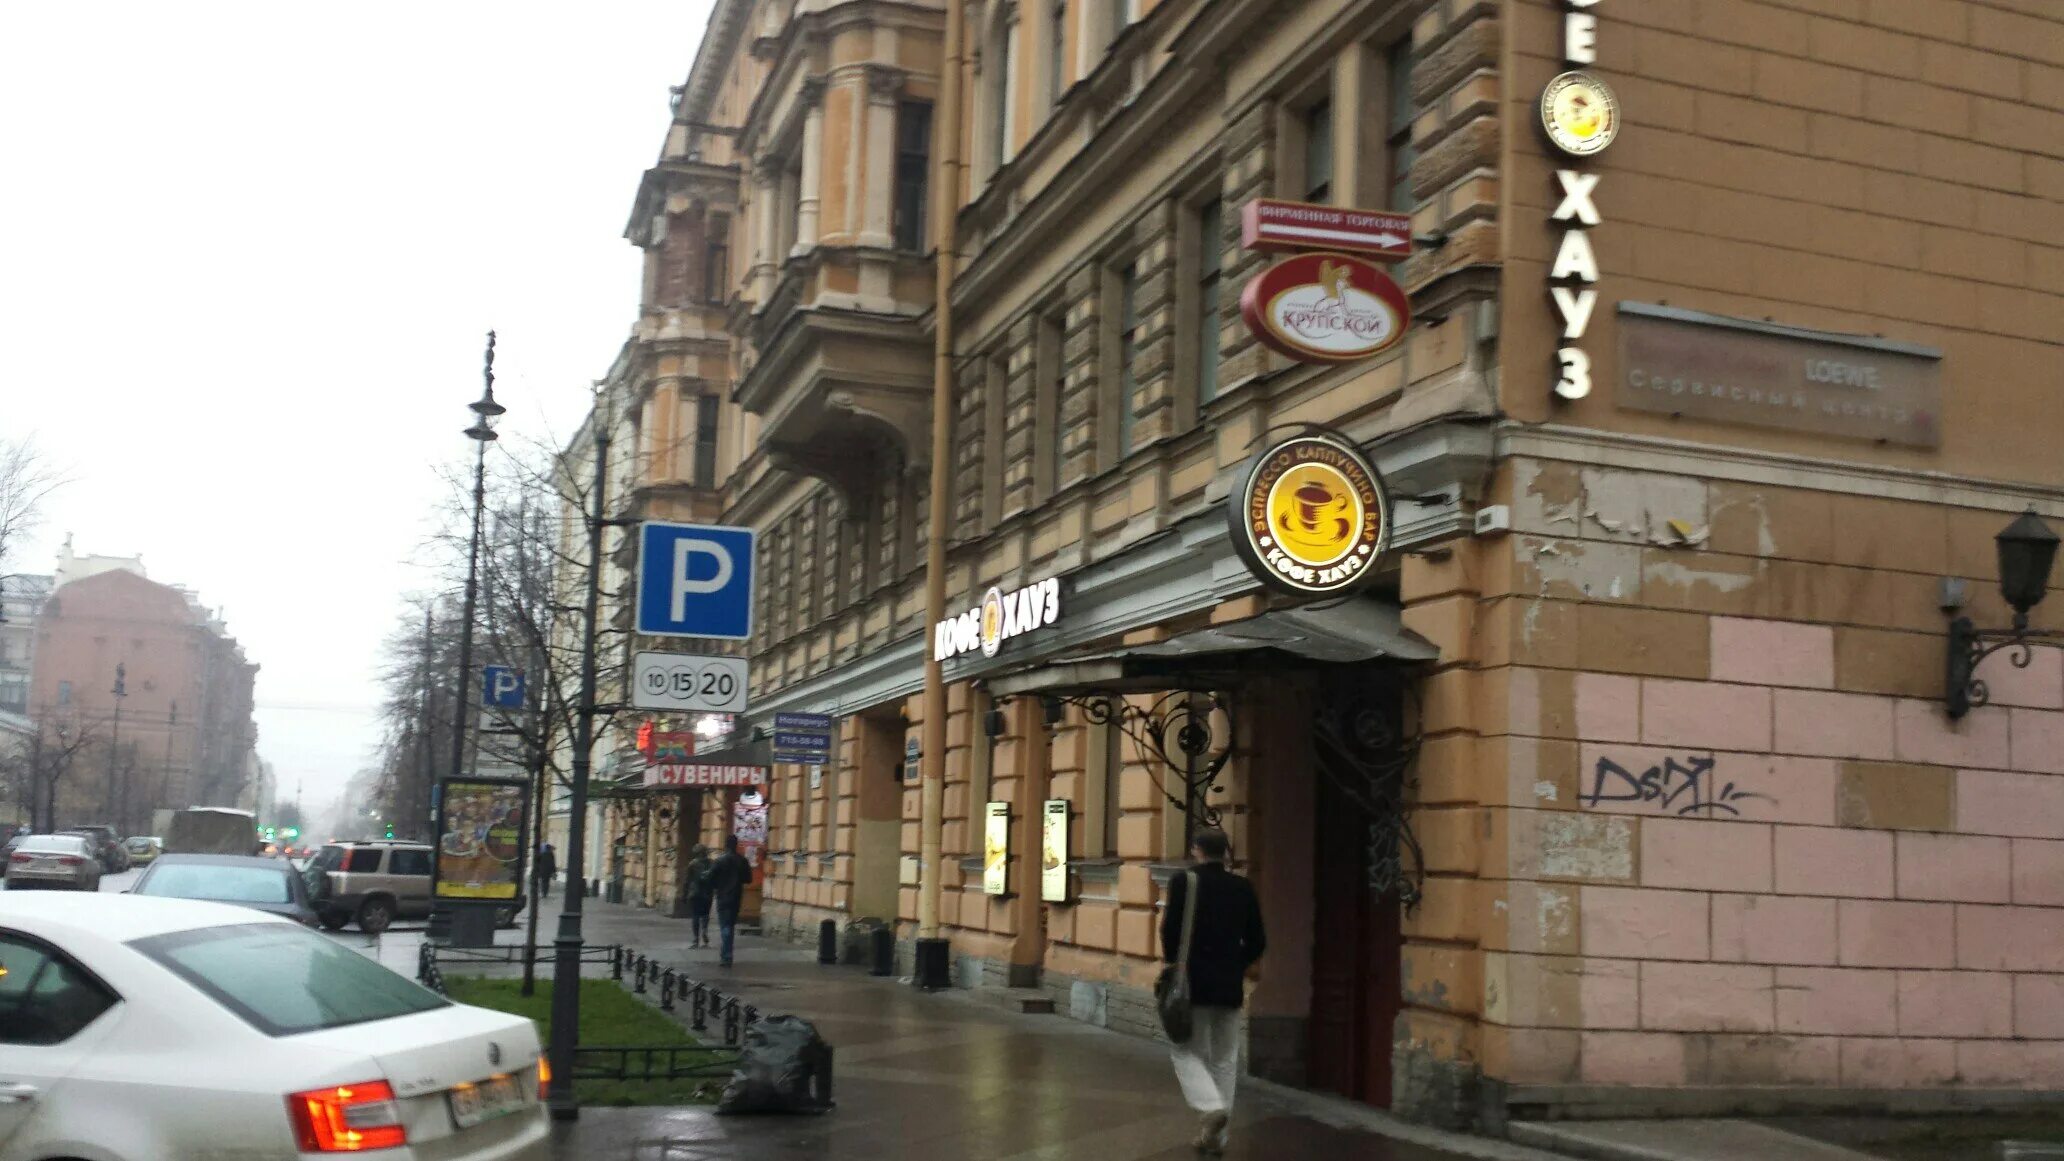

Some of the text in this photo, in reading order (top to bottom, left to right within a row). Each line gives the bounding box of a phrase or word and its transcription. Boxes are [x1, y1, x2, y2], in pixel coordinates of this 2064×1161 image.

[1552, 170, 1601, 399] ХАУЗ
[1629, 368, 1807, 408] Сервисный
[1805, 358, 1883, 390] LOEWE
[1295, 447, 1377, 505] КАППУЧИНО
[1363, 511, 1378, 542] БАР
[671, 538, 734, 623] P
[1266, 547, 1364, 584] КОФЕ ХАУЗ
[934, 577, 1060, 662] КОФЕ ХАУЗ
[648, 672, 734, 697] 10 15 20
[658, 763, 767, 785] СУВЕНИРЫ
